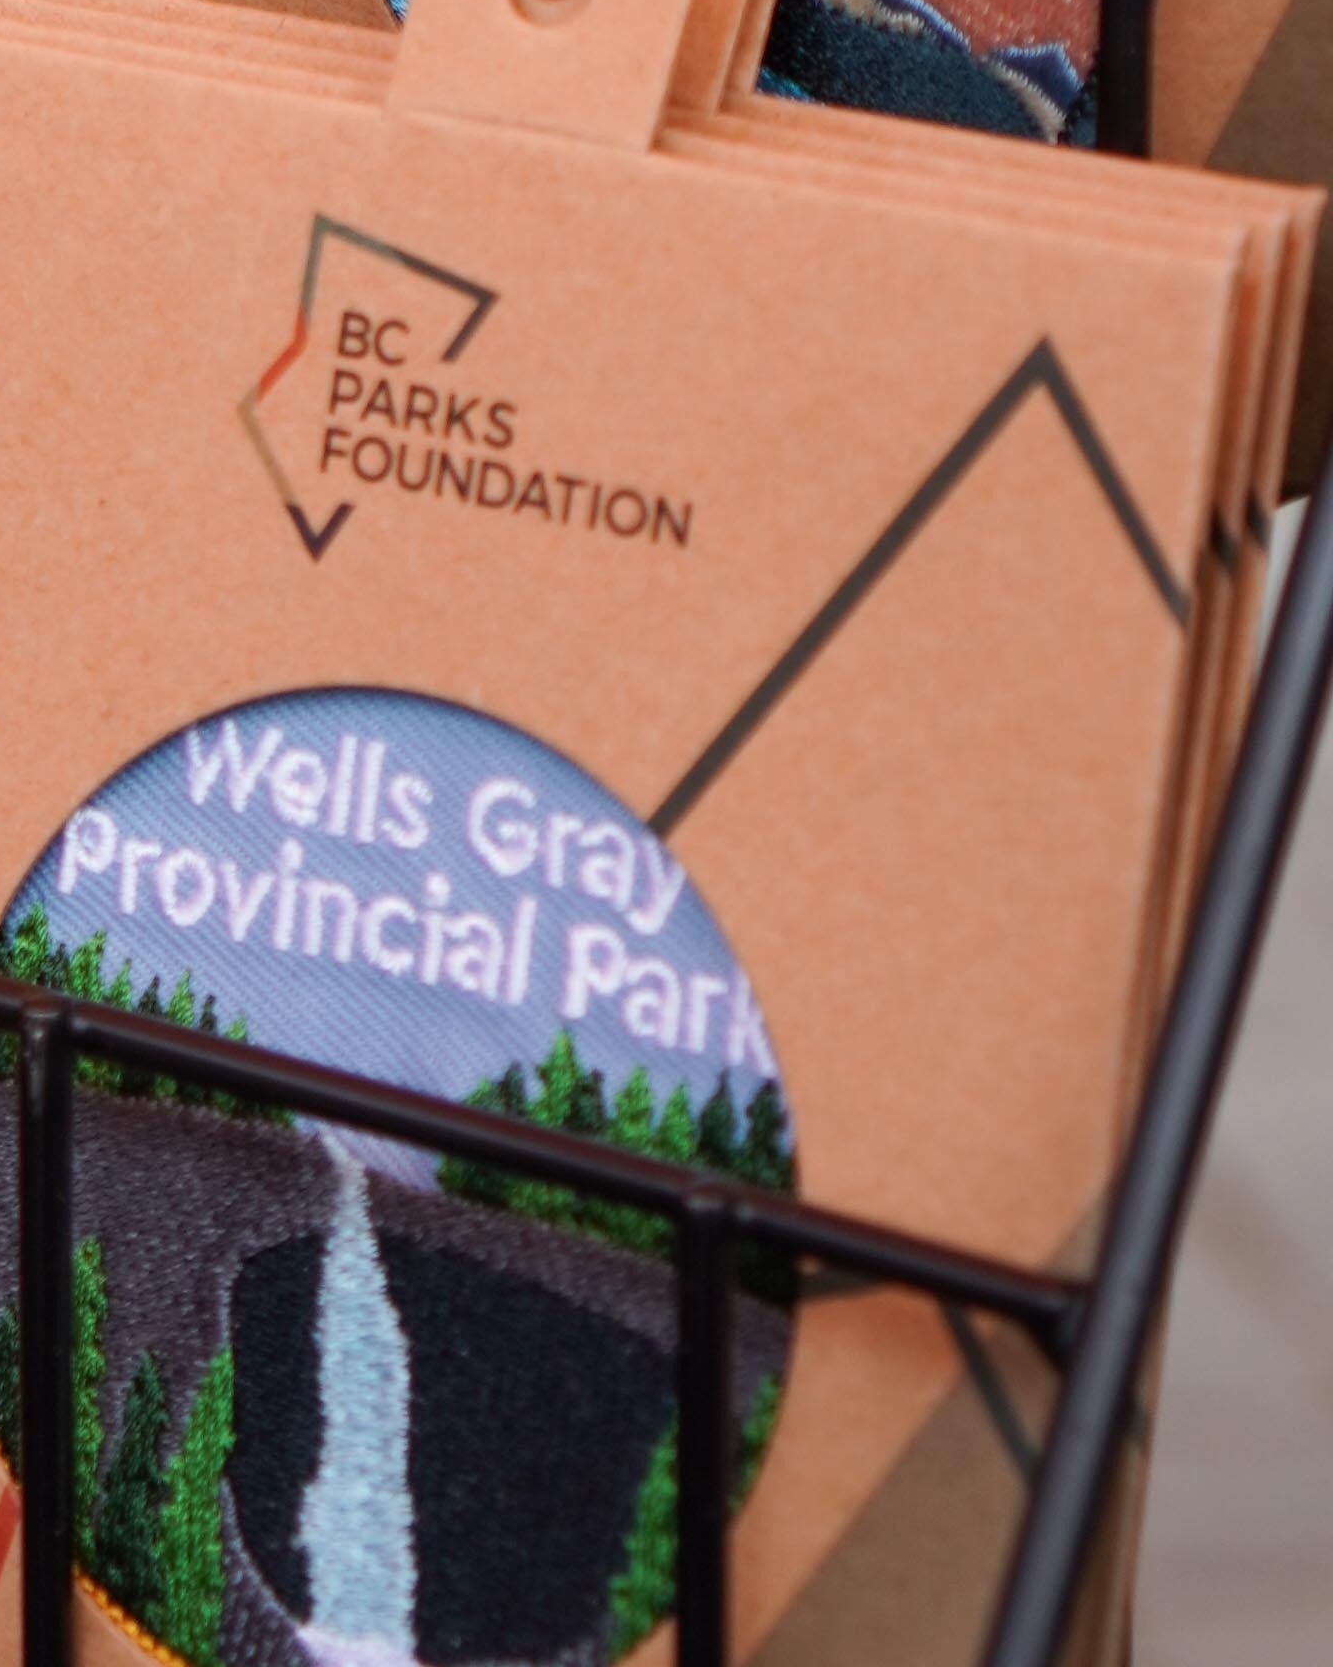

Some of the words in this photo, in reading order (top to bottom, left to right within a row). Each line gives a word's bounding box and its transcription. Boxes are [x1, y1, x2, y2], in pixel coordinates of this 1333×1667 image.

[336, 310, 411, 367] BC
[328, 368, 518, 450] PARKS
[319, 426, 693, 549] FOUNDATION
[186, 718, 434, 850] Wells
[467, 776, 687, 936] Gray
[58, 807, 537, 1006] Provincial
[562, 923, 778, 1078] Park
